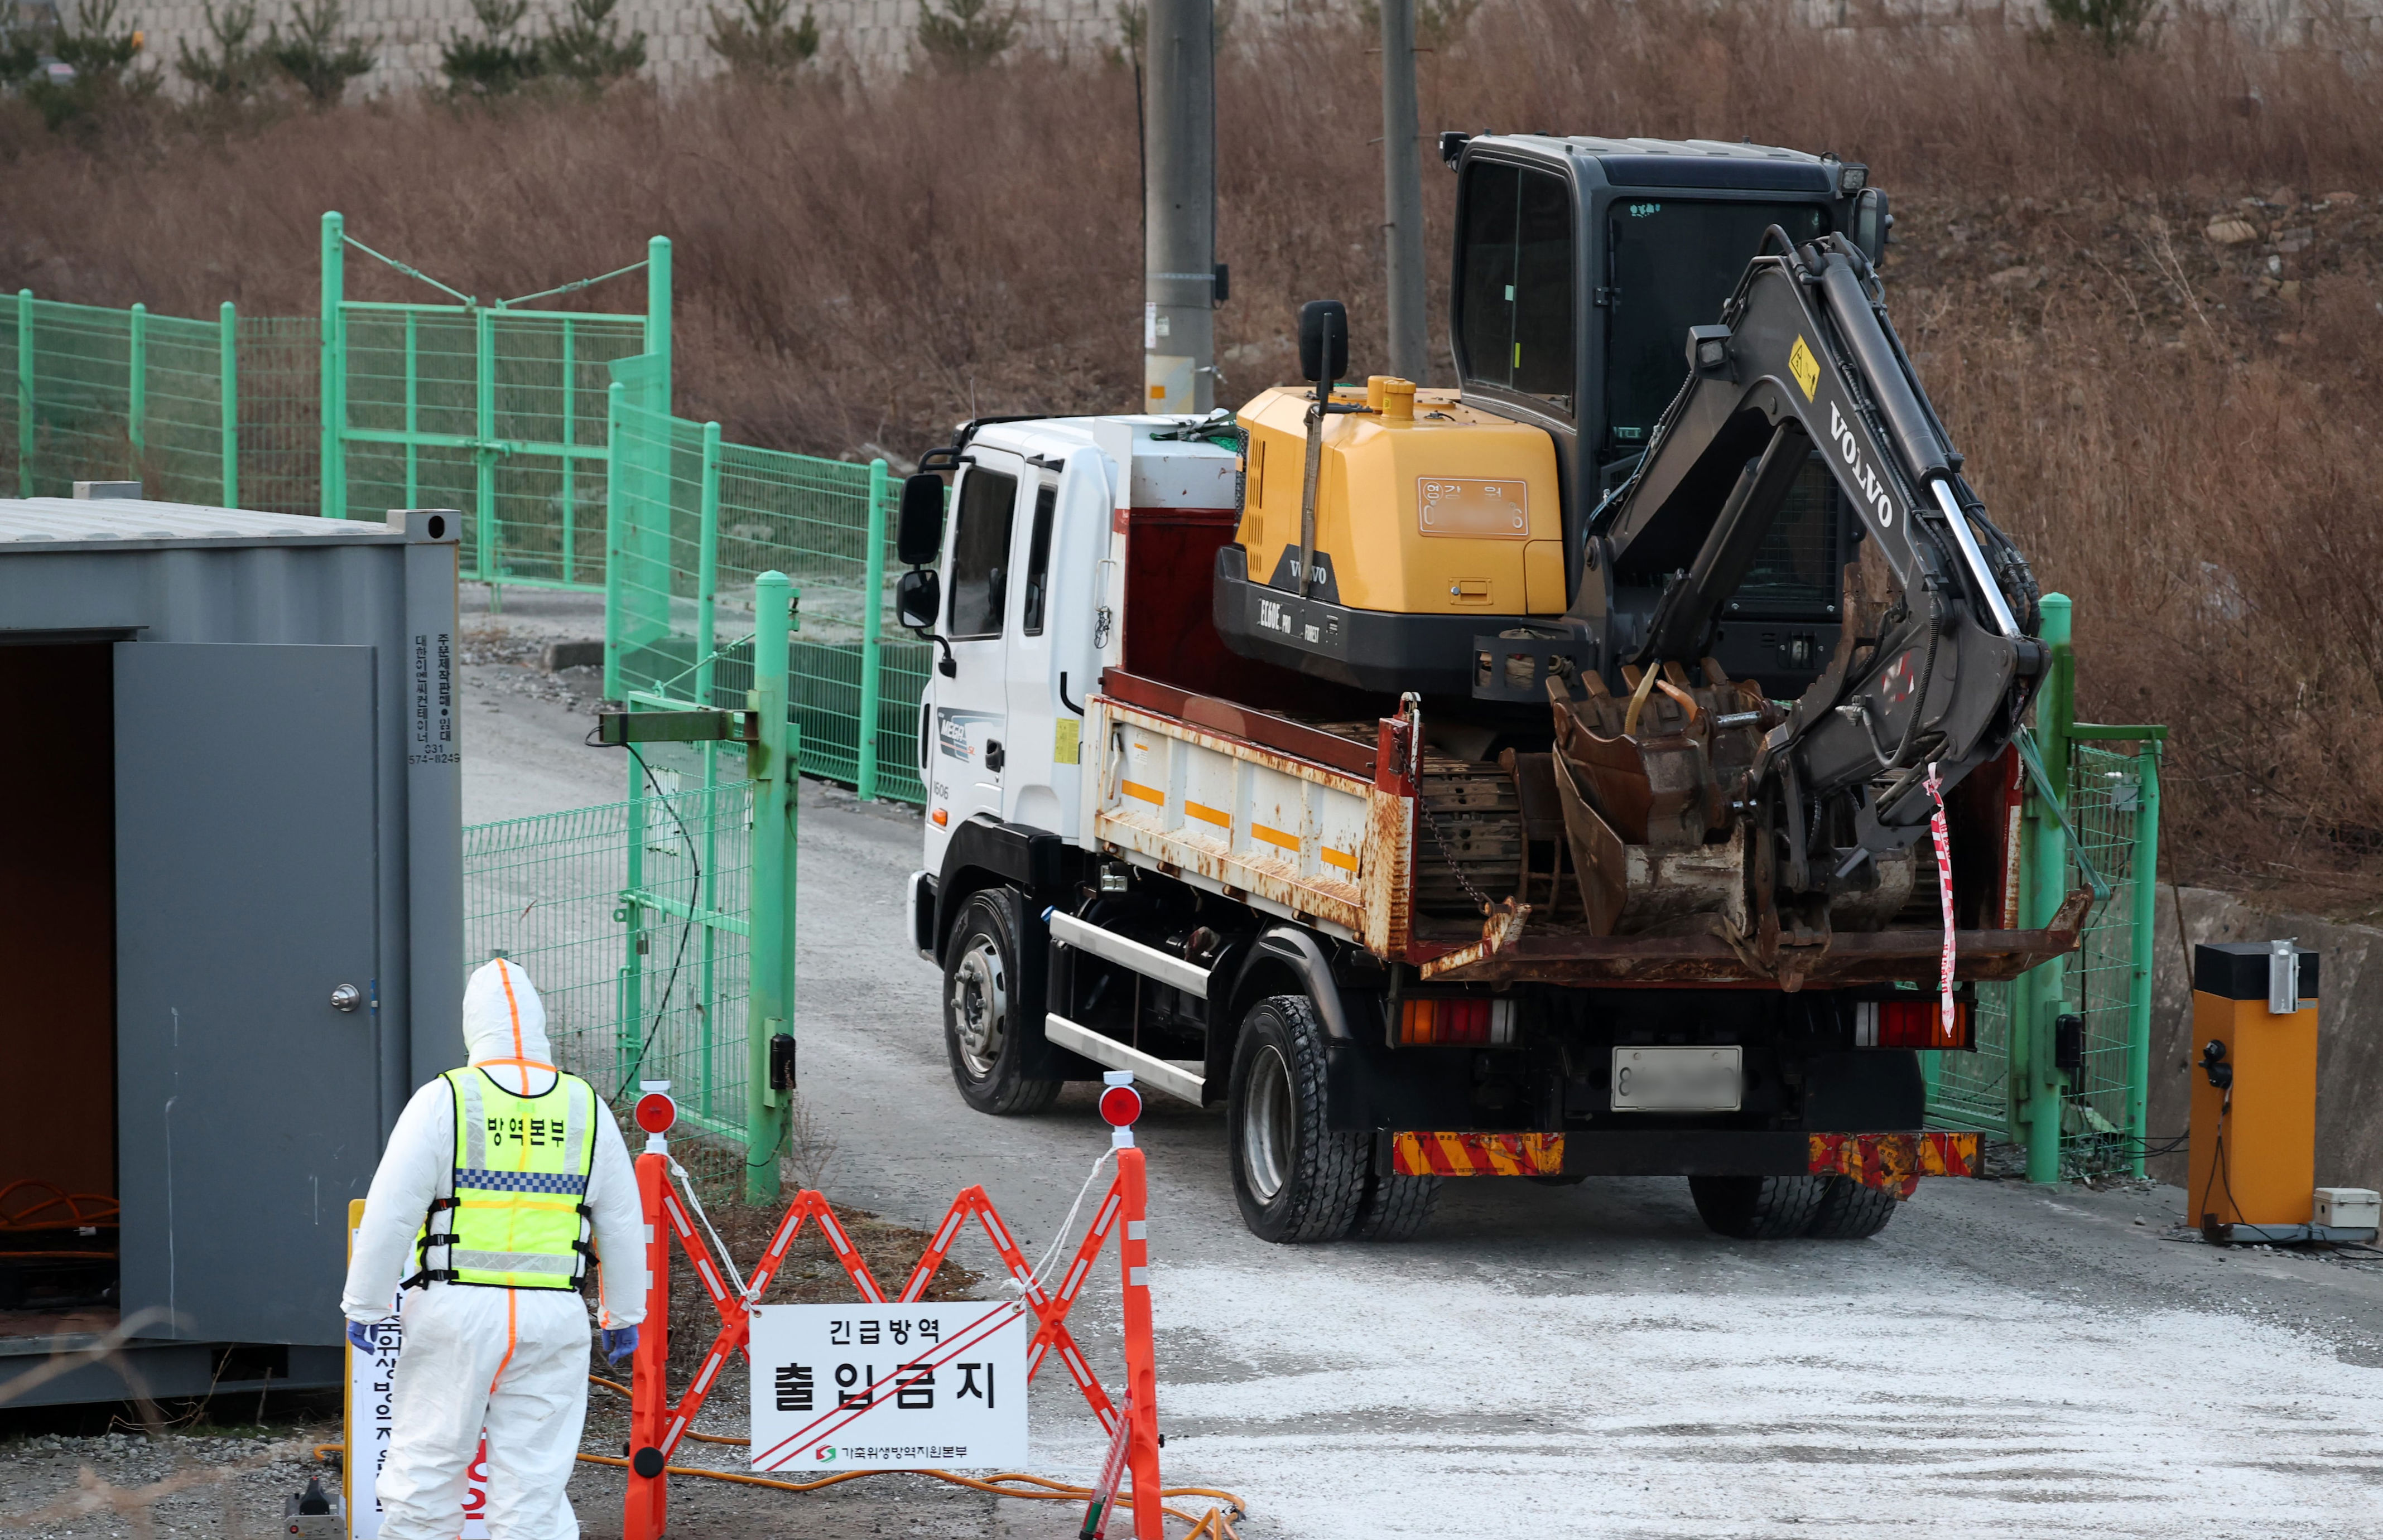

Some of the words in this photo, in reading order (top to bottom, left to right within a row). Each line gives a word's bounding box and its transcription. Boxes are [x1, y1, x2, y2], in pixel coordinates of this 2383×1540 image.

[1830, 400, 1893, 528] VOLVO
[1289, 559, 1327, 585] VVO
[1260, 599, 1280, 630] EC60E
[941, 719, 964, 741] MEGA
[488, 1118, 564, 1148] 방역본부
[830, 1319, 940, 1345] 긴급방역
[774, 1362, 995, 1411] 출입금지
[841, 1446, 967, 1459] 가축위생방역지원본부
